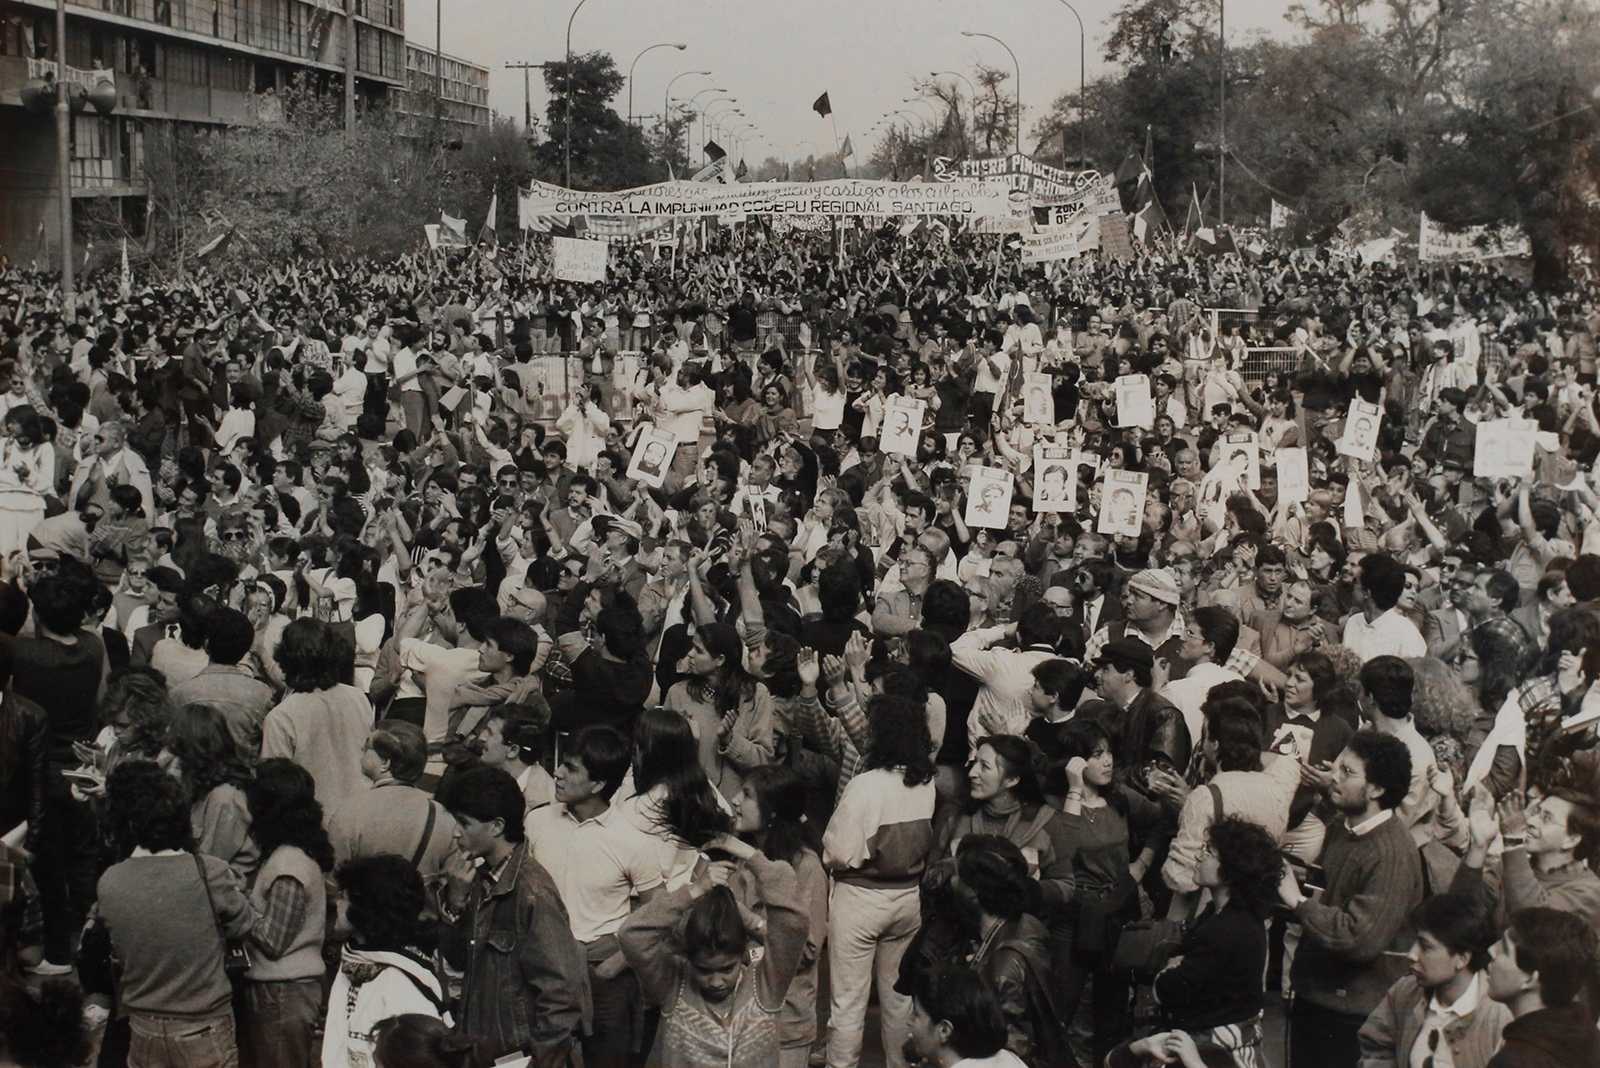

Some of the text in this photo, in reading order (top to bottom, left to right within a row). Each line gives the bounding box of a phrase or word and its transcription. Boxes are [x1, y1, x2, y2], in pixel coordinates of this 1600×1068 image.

[962, 158, 1007, 176] FUERA
[1012, 154, 1075, 184] PINOCHET
[823, 181, 886, 201] castigo
[555, 201, 625, 214] CONTRA
[629, 201, 652, 215] LA
[655, 201, 739, 215] IMPUNIDAD
[810, 200, 885, 213] REGIONAL
[892, 201, 976, 214] SANTIAGO.
